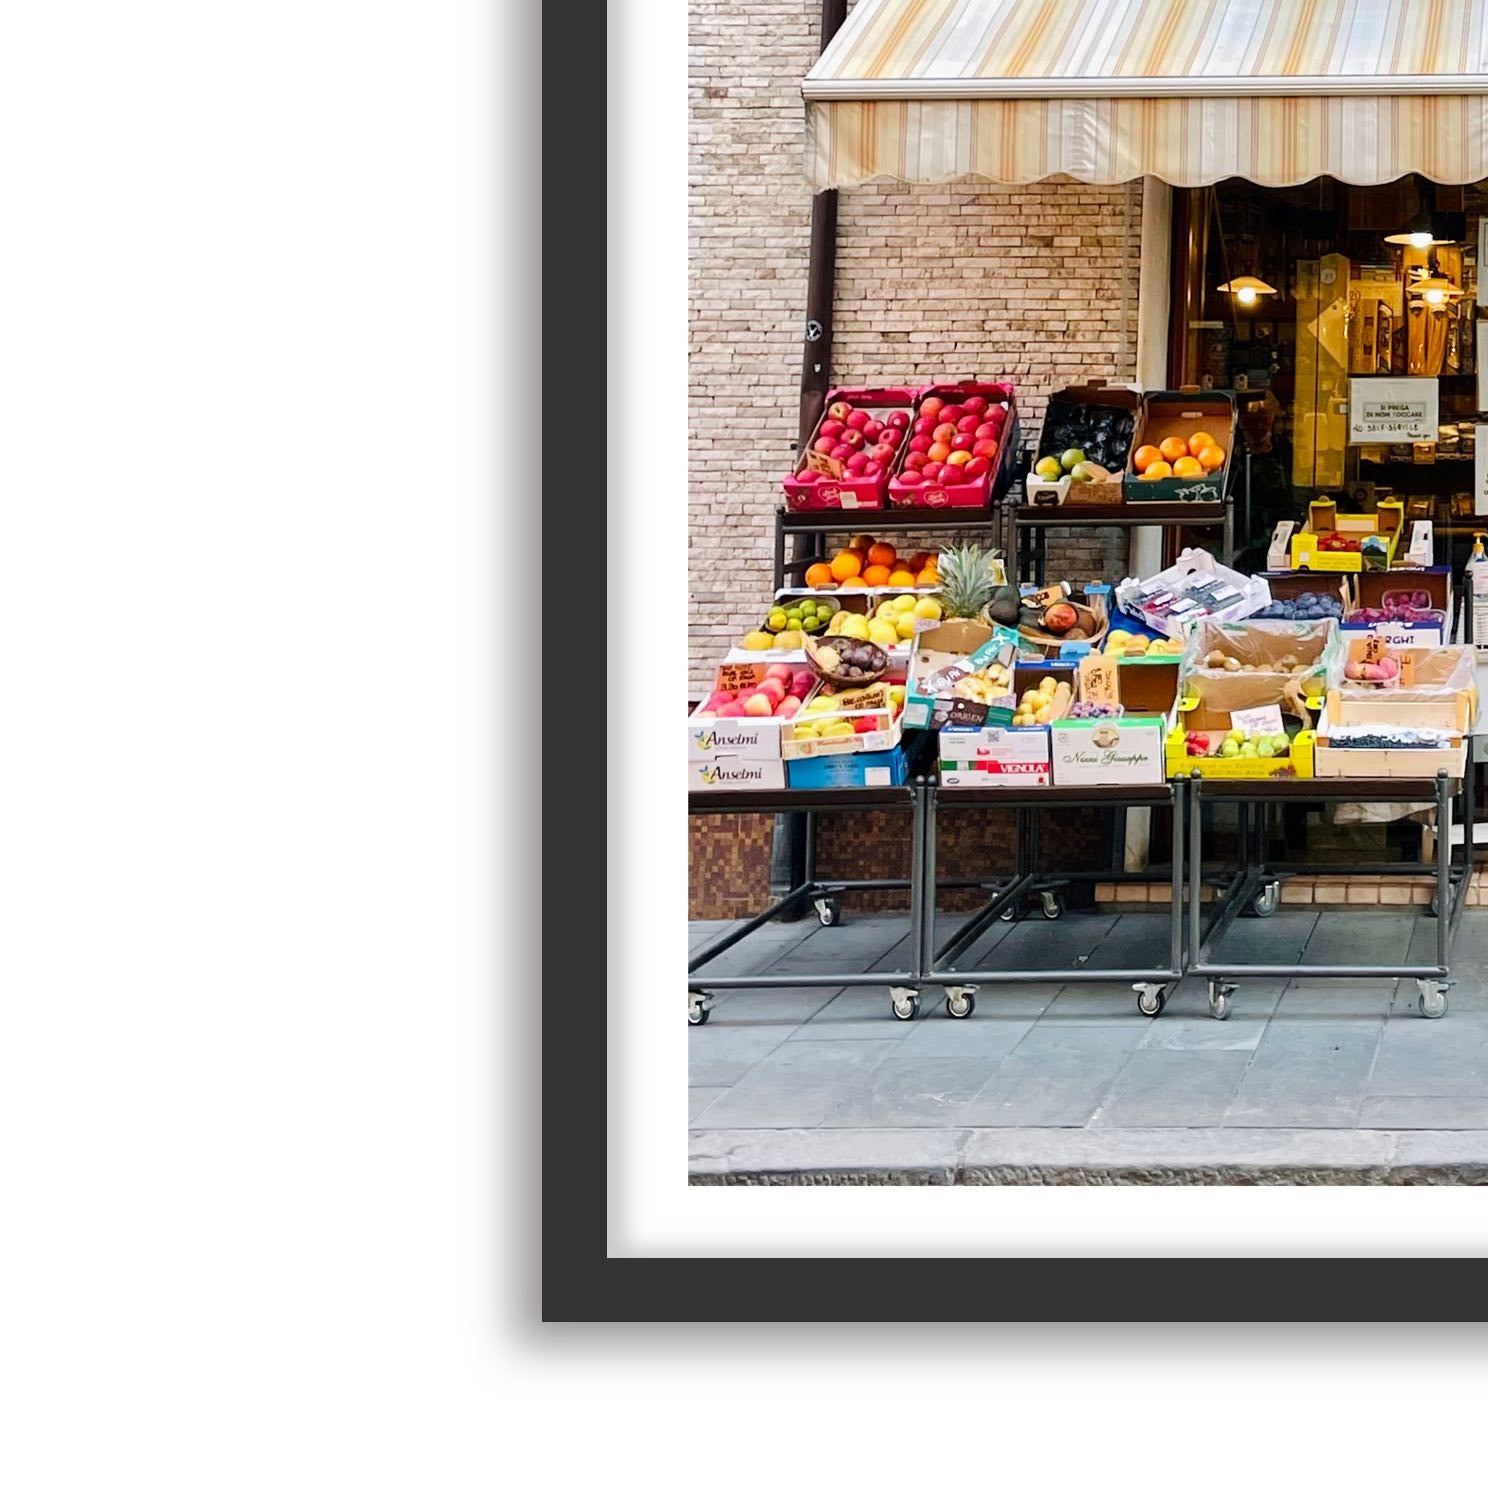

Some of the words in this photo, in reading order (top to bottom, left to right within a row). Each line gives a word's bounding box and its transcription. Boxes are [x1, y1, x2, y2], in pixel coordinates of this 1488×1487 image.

[705, 731, 758, 746] Anselmi
[710, 766, 762, 781] Anselmi
[1000, 764, 1044, 773] VIGNOLA
